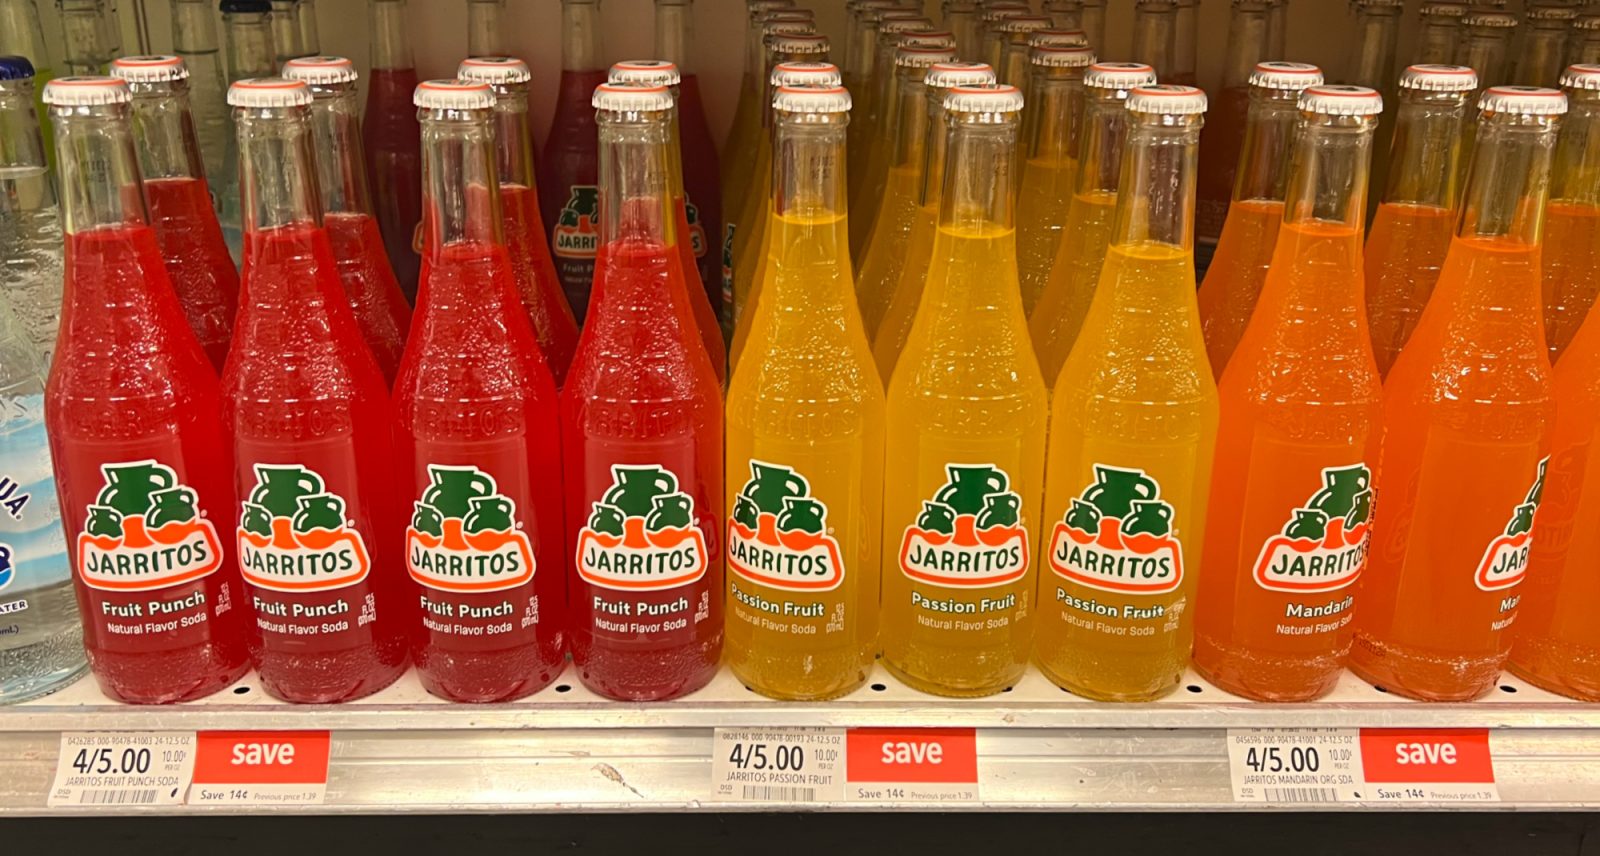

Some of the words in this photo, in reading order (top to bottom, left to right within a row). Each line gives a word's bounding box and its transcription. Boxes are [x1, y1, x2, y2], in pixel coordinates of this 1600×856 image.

[558, 234, 598, 249] JARRI
[87, 540, 207, 576] JARRITOS
[243, 546, 353, 575] JARRITOS
[412, 546, 519, 577] JARRITOS
[585, 547, 695, 575] JARRITOS
[730, 536, 827, 576] JARRITOS
[910, 544, 1019, 572] JARRITOS
[1057, 541, 1170, 579] JARRITOS
[0, 601, 26, 612] ATER
[102, 601, 142, 617] Fruit
[150, 592, 205, 615] Punch
[253, 596, 287, 617] Fruit
[292, 599, 349, 617] Punch
[420, 596, 453, 617] Fruit
[459, 601, 513, 618] Punch
[593, 596, 630, 615] Fruit
[637, 597, 688, 616] Punch
[731, 583, 780, 614] Passion
[783, 602, 825, 617] Fruit
[912, 591, 976, 613] Passion
[980, 593, 1016, 612] Fruit
[1057, 588, 1118, 617] Passion
[1123, 605, 1164, 619] Fruit
[107, 622, 143, 634] Natural
[145, 621, 178, 633] Flavor
[181, 612, 207, 627] Soda
[257, 618, 286, 633] Natural
[288, 624, 318, 635] Flavor
[322, 621, 349, 633] Soda
[423, 617, 451, 633] Natural
[454, 625, 484, 636] Flavor
[487, 622, 512, 635] Soda
[595, 617, 628, 633] Natural
[630, 622, 661, 634] Flavor
[663, 618, 687, 631] Soda
[735, 607, 760, 626] Natural
[761, 618, 788, 633] Flavor
[791, 623, 817, 635] Soda
[918, 615, 952, 630] Natural
[955, 621, 984, 631] Flavor
[987, 616, 1009, 629] Soda
[1061, 611, 1094, 630] Natural
[1096, 622, 1127, 636] Flavor
[1130, 626, 1155, 636] Soda
[1276, 624, 1313, 635] Natural
[1315, 621, 1340, 634] Flavor
[73, 748, 151, 774] 4/5.00
[231, 743, 295, 765] save
[729, 743, 804, 771] 4/5.00
[881, 742, 943, 764] save
[1246, 747, 1319, 772] 4/5.00
[1396, 743, 1457, 765] save
[66, 777, 102, 786] JARRITOS
[104, 777, 125, 786] FRUIT
[127, 777, 155, 786] PUNCH
[157, 777, 179, 786] SODA
[726, 771, 767, 783] JARRITOS
[769, 773, 806, 784] PASSION
[808, 774, 832, 785] FRUIT
[1244, 775, 1277, 784] JARRITOS
[1279, 775, 1318, 784] MANDARIN
[1321, 775, 1336, 784] ORG
[1339, 775, 1353, 784] SDA
[200, 789, 224, 800] Save
[230, 790, 248, 800] 14¢
[858, 788, 881, 799] Save
[886, 788, 904, 799] 14¢
[911, 792, 938, 800] Previous
[940, 793, 956, 801] price
[1378, 789, 1401, 799] Save
[1405, 789, 1424, 799] 14¢
[1430, 792, 1459, 800] Previous
[1460, 793, 1476, 801] price
